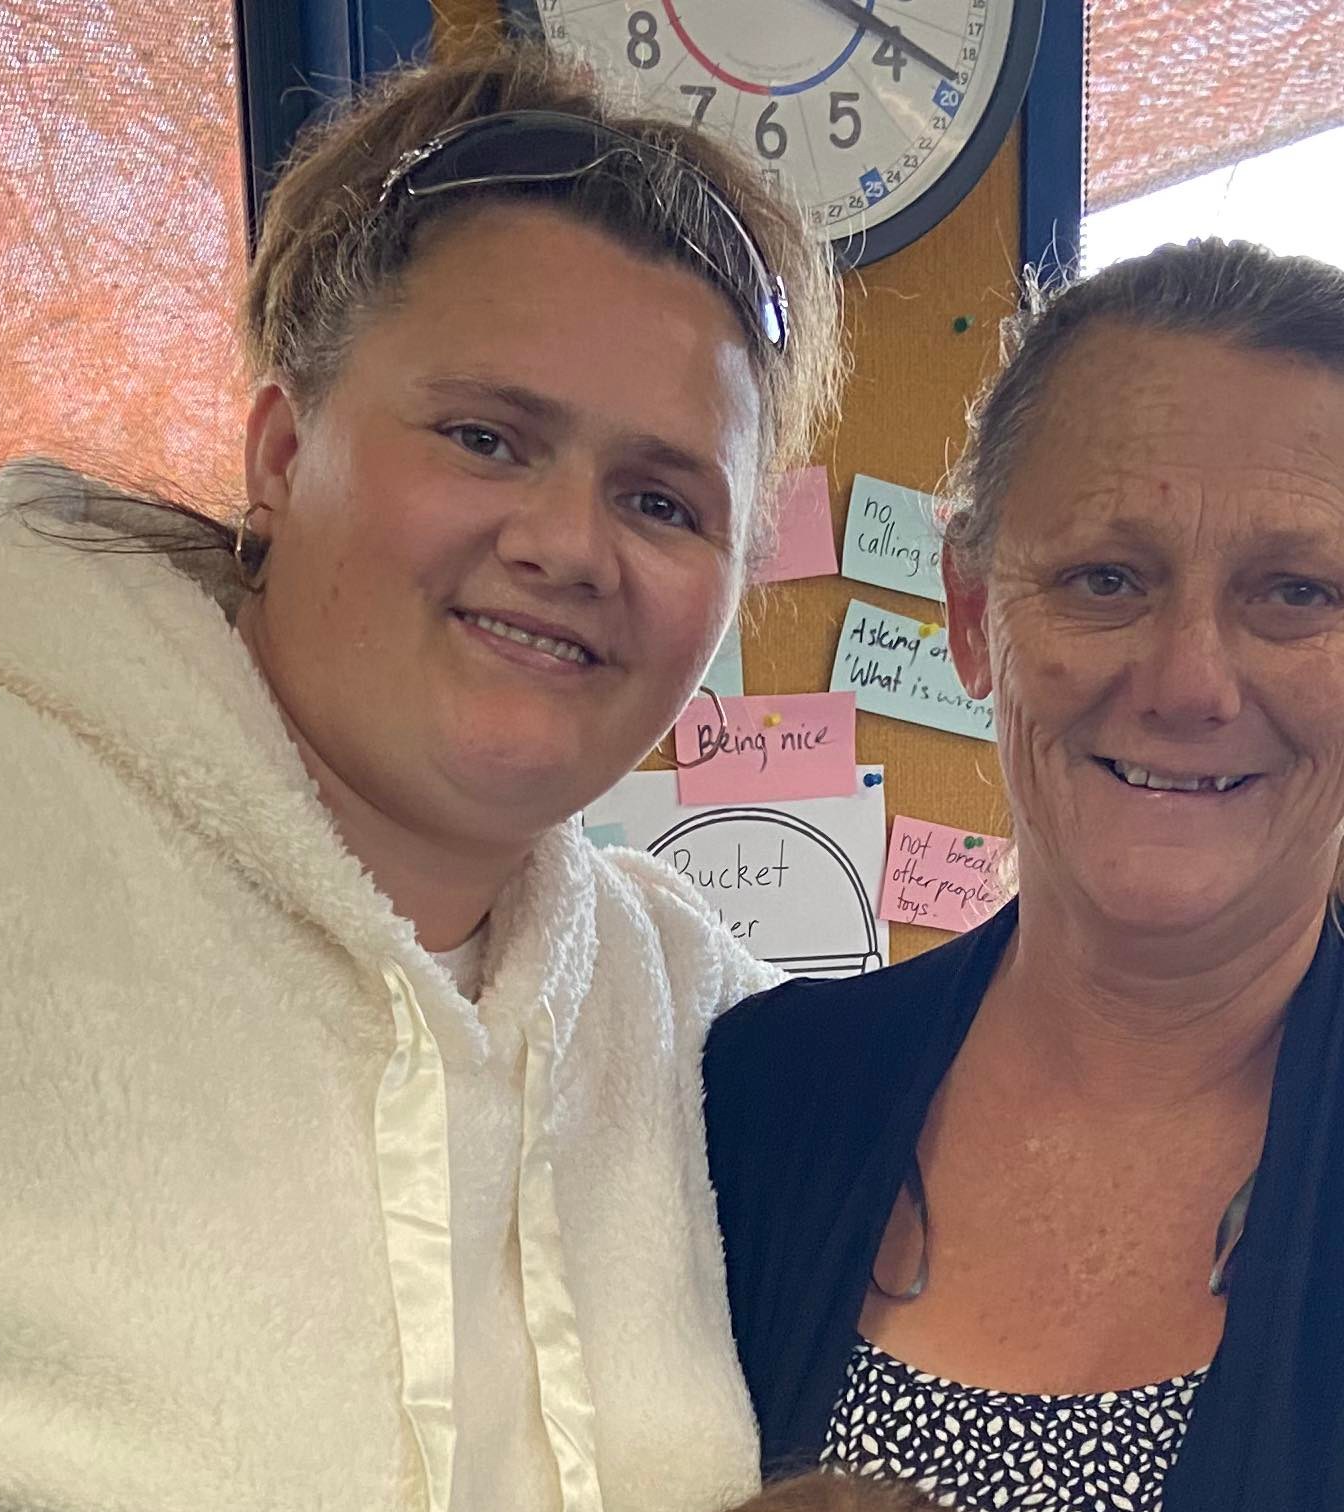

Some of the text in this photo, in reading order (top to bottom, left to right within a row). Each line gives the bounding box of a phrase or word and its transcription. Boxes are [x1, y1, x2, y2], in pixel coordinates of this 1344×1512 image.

[626, 10, 661, 69] 8
[968, 22, 984, 35] 17
[872, 26, 907, 82] 4
[962, 47, 977, 61] 18
[680, 85, 717, 127] 7
[939, 90, 959, 106] 20
[755, 101, 787, 159] 6
[829, 92, 861, 149] 5
[932, 116, 947, 130] 21
[918, 137, 933, 150] 22
[903, 155, 919, 168] 23
[886, 170, 902, 184] 24
[864, 181, 884, 198] 25
[828, 204, 843, 218] 27
[848, 195, 864, 209] 26
[864, 496, 892, 523] no
[858, 521, 920, 577] calling
[850, 618, 921, 667] Asking
[911, 677, 929, 699] is
[697, 723, 836, 772] Being nice
[900, 831, 932, 859] not
[892, 858, 938, 888] other
